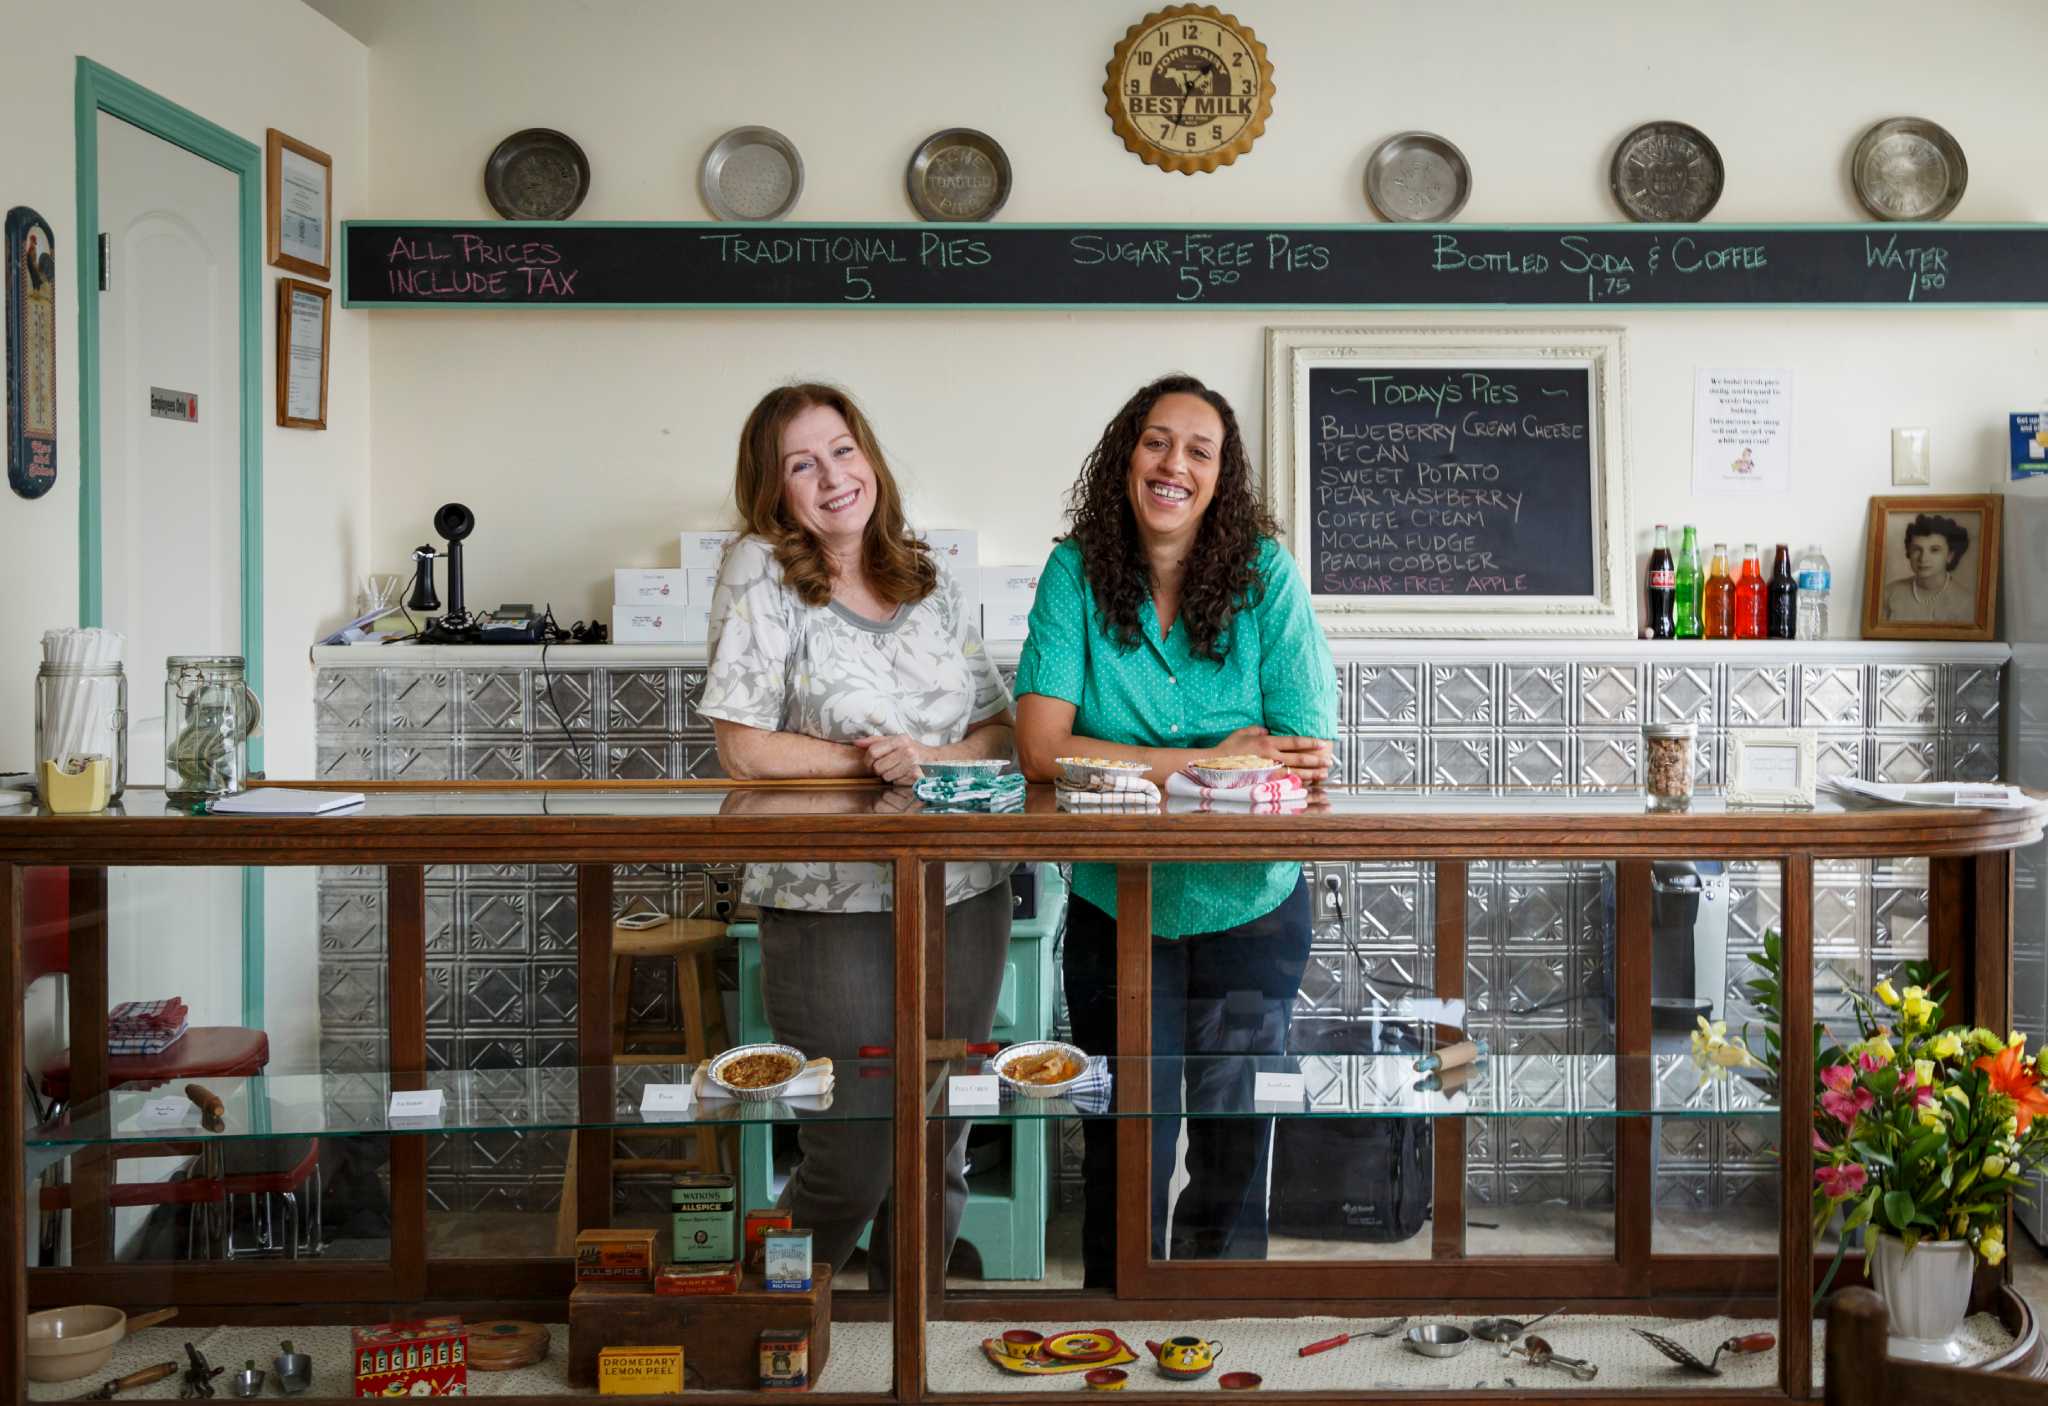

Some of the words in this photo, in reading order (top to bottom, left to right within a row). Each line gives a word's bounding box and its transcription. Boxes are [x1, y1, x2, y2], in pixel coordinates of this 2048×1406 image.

[1159, 32, 1169, 46] 11
[1183, 25, 1198, 39] 12
[1216, 32, 1221, 47] 1
[1138, 52, 1152, 65] 10
[1157, 47, 1189, 75] JOHN
[1232, 53, 1242, 67] 2
[1131, 80, 1140, 94] 9
[1242, 80, 1251, 94] 3
[1129, 97, 1185, 115] BEST
[1195, 97, 1252, 115] MILK
[1160, 125, 1170, 139] 7
[1186, 132, 1196, 147] 6
[1212, 125, 1222, 140] 5
[388, 236, 450, 263] ALL
[452, 234, 561, 264] PRICES
[700, 233, 907, 264] TRADITIONAL
[919, 232, 992, 267] PIES
[1070, 234, 1254, 267] SUGAR-FREE
[1266, 234, 1330, 271] PIES
[1432, 234, 1549, 273] BOTTLED
[1560, 235, 1635, 273] SODA
[1672, 236, 1768, 273] COFFEE
[1865, 232, 1949, 274] WATER
[388, 270, 508, 295] INCLUDE
[516, 267, 578, 296] TAX
[1357, 375, 1462, 418] TODAY'S
[1462, 372, 1519, 404] PIES
[1320, 415, 1456, 453] BLUEBERRY
[1462, 411, 1517, 438] CREAM
[1522, 414, 1584, 439] CHEESE
[1317, 441, 1410, 464] PECAN
[1320, 466, 1403, 485] SWEET
[1417, 463, 1500, 486] POTATO
[1317, 485, 1381, 507] PEAR
[1382, 487, 1523, 524] RASPBERRY
[1317, 510, 1399, 529] COFFEE
[1411, 509, 1486, 528] CREAM
[1321, 531, 1398, 550] MOCHA
[1405, 533, 1476, 553] FUDGE
[1320, 551, 1381, 574] PEACH
[1388, 551, 1500, 573] COBBLER
[1465, 573, 1528, 593] APPLE
[682, 1191, 721, 1201] WATKINS
[680, 1203, 722, 1211] ALLSPICE
[582, 1268, 641, 1277] ALLSPICE
[361, 1347, 462, 1370] RECIPES
[603, 1358, 677, 1367] DROMEDARY
[605, 1367, 642, 1376] LEMON
[646, 1367, 673, 1376] PEEL
